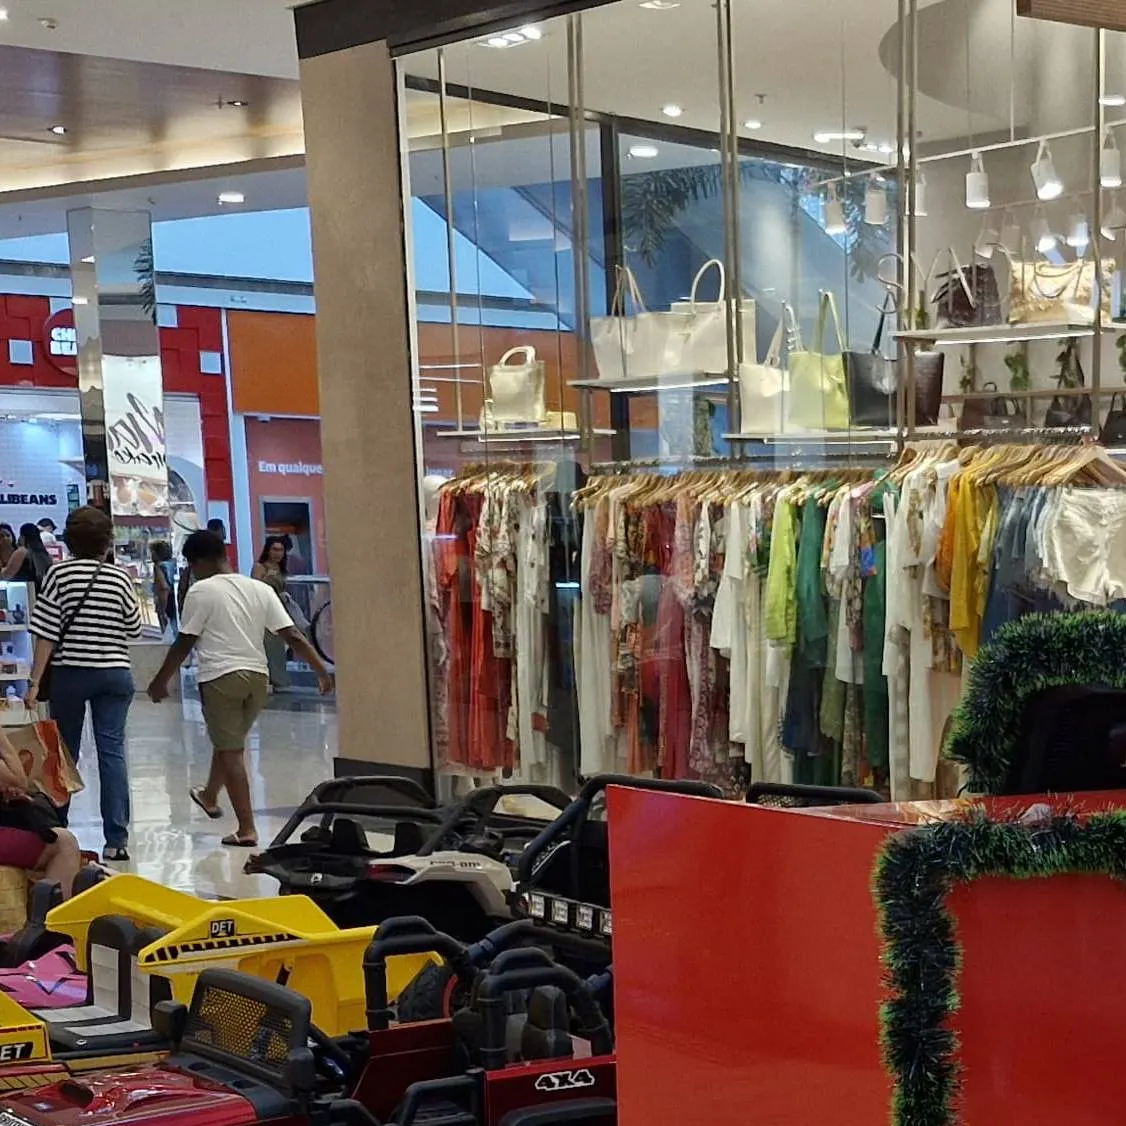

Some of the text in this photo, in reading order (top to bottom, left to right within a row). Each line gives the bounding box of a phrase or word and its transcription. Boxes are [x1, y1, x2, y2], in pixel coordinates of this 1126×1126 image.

[258, 460, 324, 476] Em qualque
[0, 494, 57, 505] LIBEANS
[0, 1043, 26, 1060] ET
